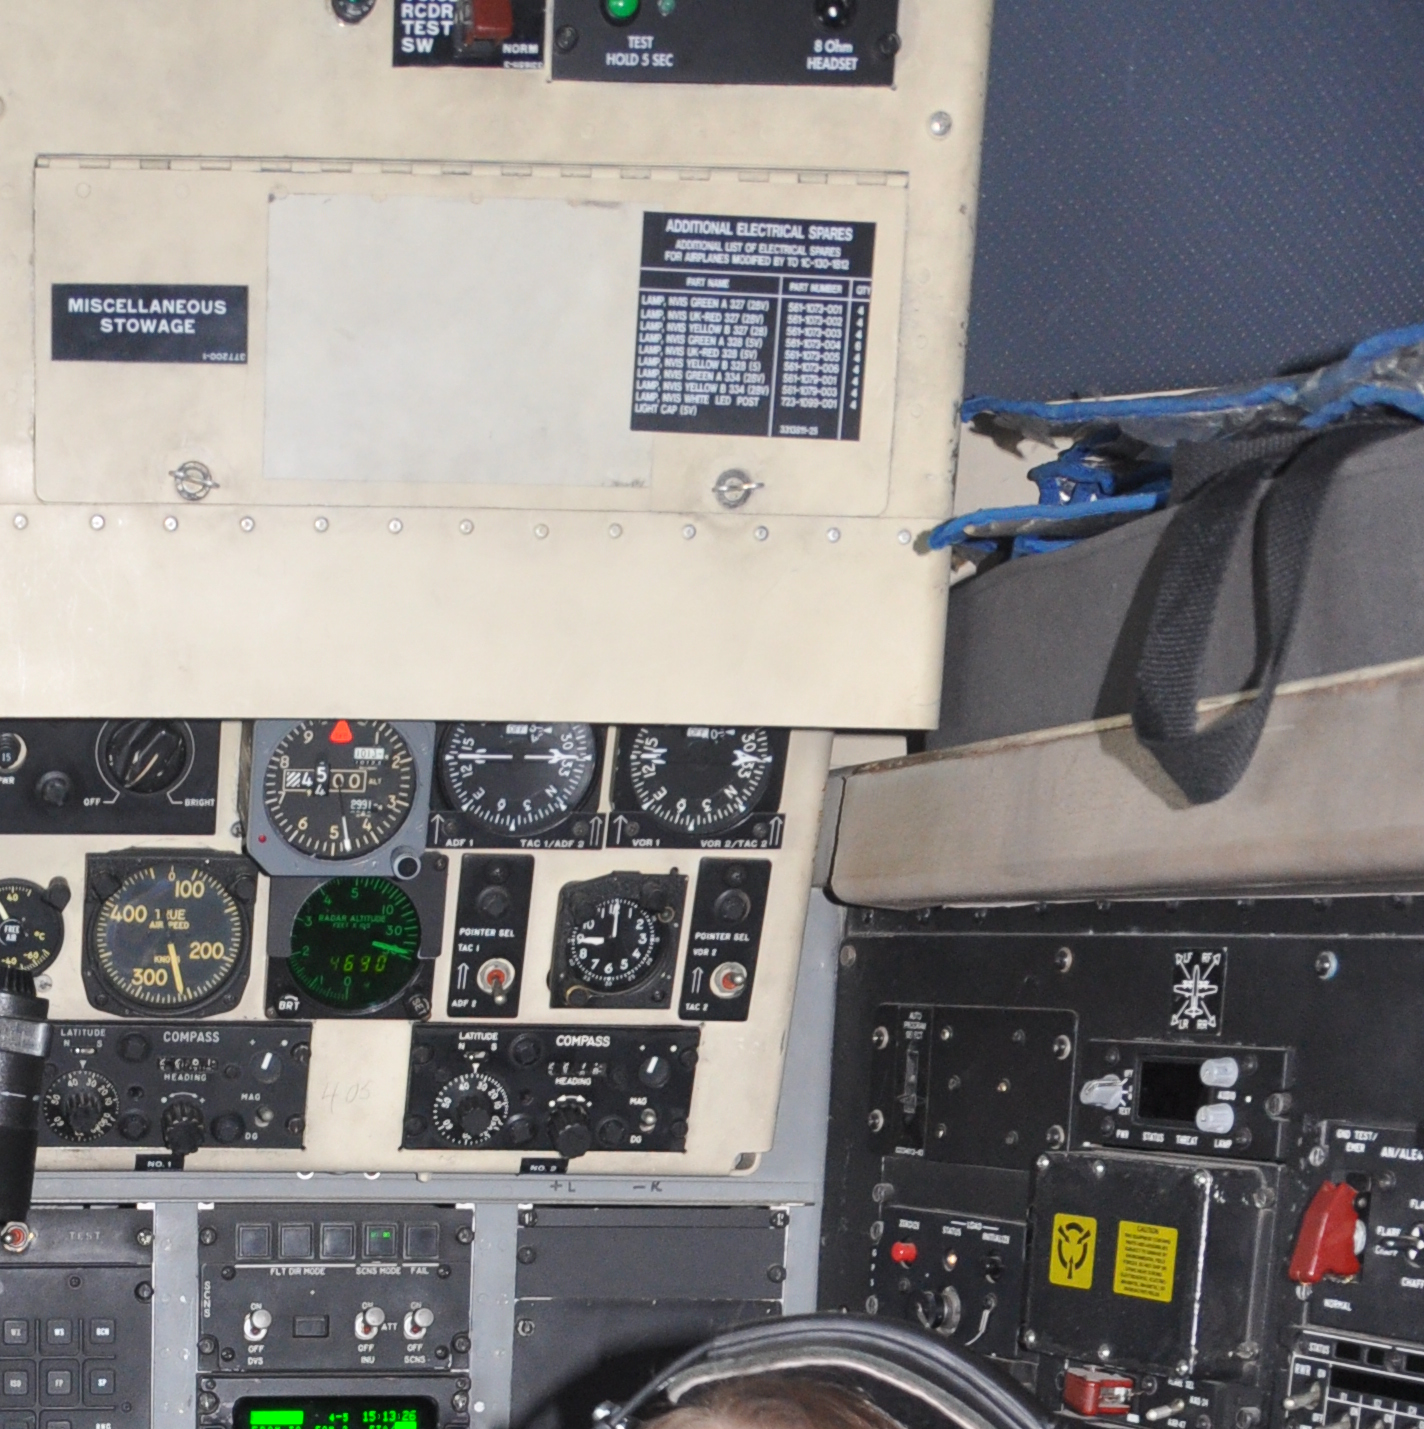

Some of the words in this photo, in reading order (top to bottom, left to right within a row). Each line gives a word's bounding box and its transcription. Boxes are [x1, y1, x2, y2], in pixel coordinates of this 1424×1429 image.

[402, 3, 454, 19] RCDR
[402, 20, 454, 36] TEST
[402, 38, 434, 53] SW
[628, 36, 654, 49] TEST
[815, 40, 823, 52] 8
[824, 39, 853, 53] Ohm
[502, 43, 539, 54] NORM
[606, 52, 639, 66] HOLD
[642, 53, 650, 66] 5
[652, 53, 674, 67] SEC
[806, 57, 858, 71] HEADSET
[665, 218, 733, 236] ADDITIONAL
[736, 221, 805, 239] ELECTRICAL
[808, 226, 854, 242] SPARES
[675, 239, 722, 252] ADDITIONAL
[725, 242, 743, 252] LIST
[758, 243, 807, 256] ELECTRICAL
[809, 246, 842, 257] SPARES
[685, 252, 730, 265] AIRPLANES
[732, 254, 770, 266] MODIFIED
[686, 277, 705, 287] PART
[707, 278, 730, 288] NAME
[789, 282, 808, 293] PART
[810, 283, 843, 294] NUMBER
[68, 298, 227, 315] MISCELLANEOUS
[100, 318, 196, 334] STOWAGE
[83, 797, 101, 807] OFF
[184, 798, 215, 807] BRIGHT
[445, 838, 466, 847] ADF
[520, 838, 539, 848] TAC
[542, 838, 573, 848] 1/ADF
[632, 838, 653, 848] VOR
[700, 838, 721, 848] VOR
[725, 839, 758, 849] 2/TAC
[175, 880, 205, 898] 100
[110, 904, 148, 923] 400
[318, 914, 347, 922] RADAR
[349, 914, 386, 923] ALTITUDE
[459, 928, 496, 937] POINTER
[498, 929, 515, 938] SEL
[694, 932, 732, 941] POINTER
[733, 933, 750, 942] SEL
[189, 941, 224, 959] 200
[457, 944, 473, 952] TAC
[693, 948, 709, 956] VOR
[132, 968, 168, 986] 300
[278, 1000, 301, 1011] BRT
[60, 1028, 106, 1037] LATITUDE
[163, 1031, 220, 1043] COMPASS
[459, 1031, 498, 1041] LATITUDE
[556, 1035, 610, 1048] COMPASS
[163, 1073, 207, 1082] HEADING
[555, 1076, 592, 1086] HEADING
[241, 1092, 261, 1101] MAG
[244, 1132, 258, 1141] DG
[69, 1231, 102, 1241] TEST
[270, 1267, 286, 1276] FLT
[288, 1267, 301, 1276] DIR
[303, 1267, 326, 1276] MODE
[356, 1266, 377, 1276] SCNS
[379, 1266, 401, 1275] MODE
[410, 1266, 429, 1275] FAIL
[329, 1412, 349, 1422] 4-5
[362, 1410, 417, 1423] 15:13:26
